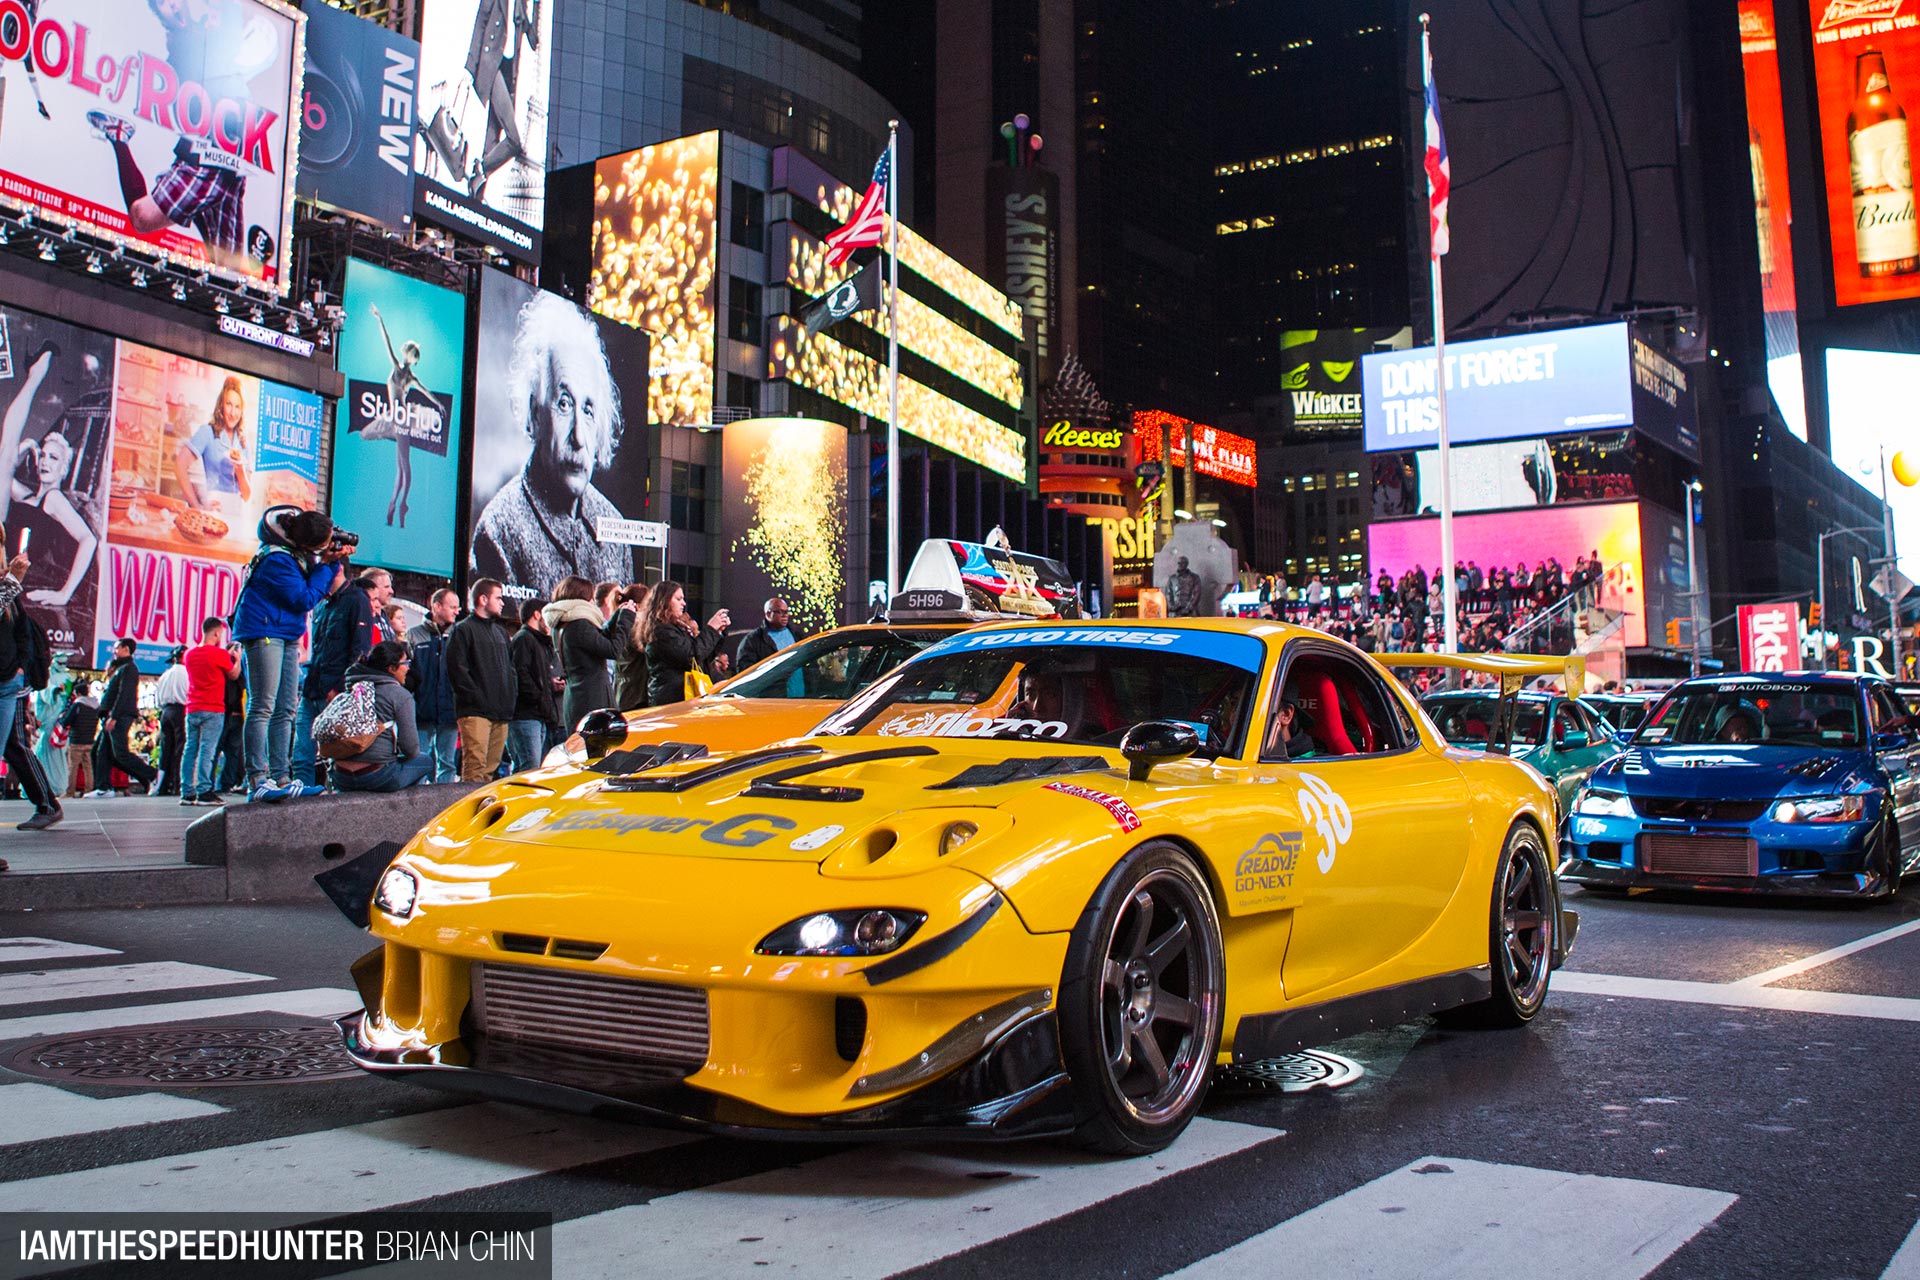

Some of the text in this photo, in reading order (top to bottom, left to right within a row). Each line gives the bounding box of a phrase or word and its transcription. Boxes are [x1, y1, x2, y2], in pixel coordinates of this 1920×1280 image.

[1815, 28, 1839, 44] THIS
[1839, 22, 1871, 40] BUD'S
[1872, 18, 1893, 34] FOR
[96, 54, 140, 103] of
[134, 51, 279, 173] ROCK
[378, 47, 415, 177] NEW
[195, 140, 208, 149] THE
[205, 151, 241, 169] MUSICAL
[4, 178, 32, 197] GARDEN
[33, 188, 63, 208] THEATRE
[1006, 193, 1047, 357] RSHEY'S
[223, 317, 311, 354] OUTFRONT PRIME
[1459, 343, 1558, 389] FORGET
[272, 397, 297, 423] LITTLE
[297, 403, 317, 428] SLICE
[360, 391, 442, 434] StubHub
[1381, 396, 1440, 436] THIS
[270, 421, 280, 443] OF
[430, 434, 442, 443] out
[1044, 420, 1123, 448] Reese's
[110, 547, 250, 648] WAITR
[502, 584, 539, 599] ncestry
[908, 594, 944, 608] 5H96
[964, 630, 1064, 647] TOYO
[1064, 630, 1182, 646] TIRES
[1736, 684, 1811, 692] AUTOBODY
[1298, 772, 1352, 874] 38
[1243, 855, 1289, 874] READY
[1235, 874, 1294, 892] GO-NEXT
